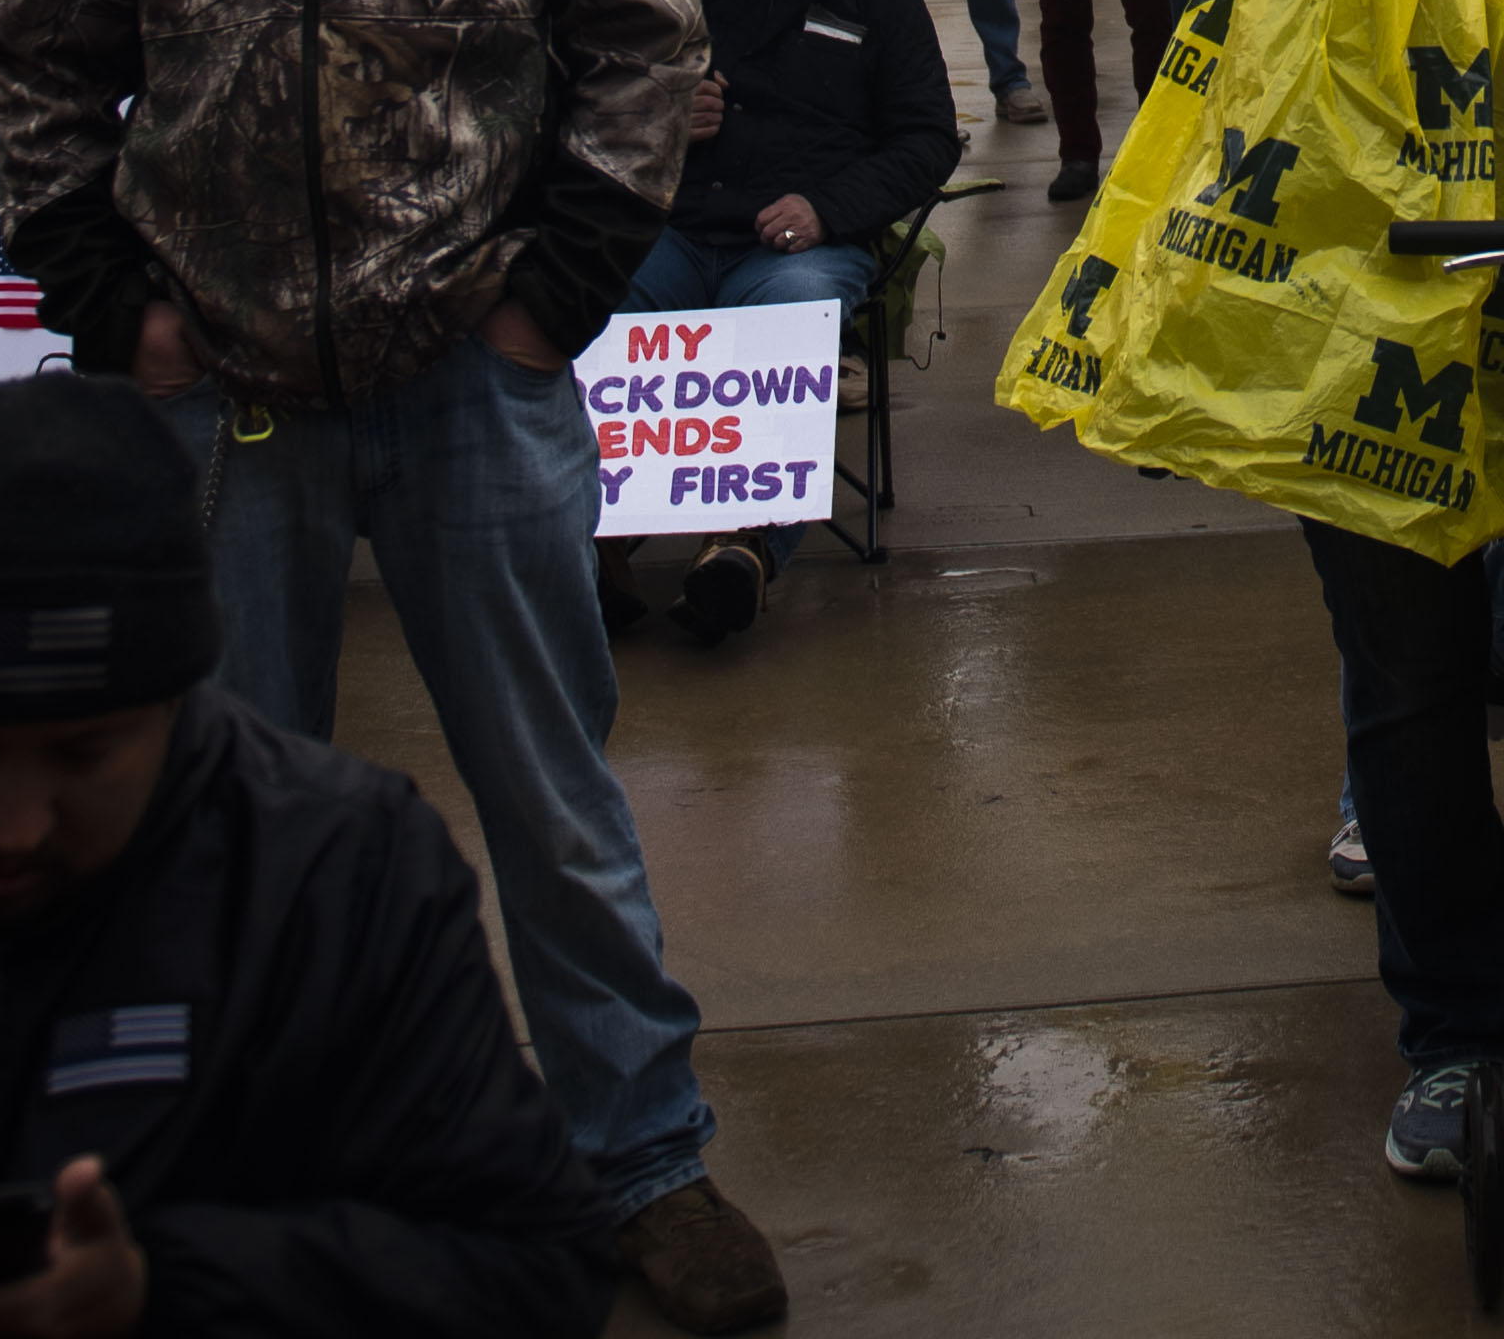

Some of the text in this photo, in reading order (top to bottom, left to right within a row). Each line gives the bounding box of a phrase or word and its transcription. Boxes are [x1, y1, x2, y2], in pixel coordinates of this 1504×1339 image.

[1158, 207, 1297, 284] MICHIGAN
[627, 323, 712, 363] MY
[1354, 337, 1475, 453] M
[598, 415, 742, 459] ENDS
[1302, 423, 1476, 512] MICHIGAN
[670, 460, 817, 505] FIRST
